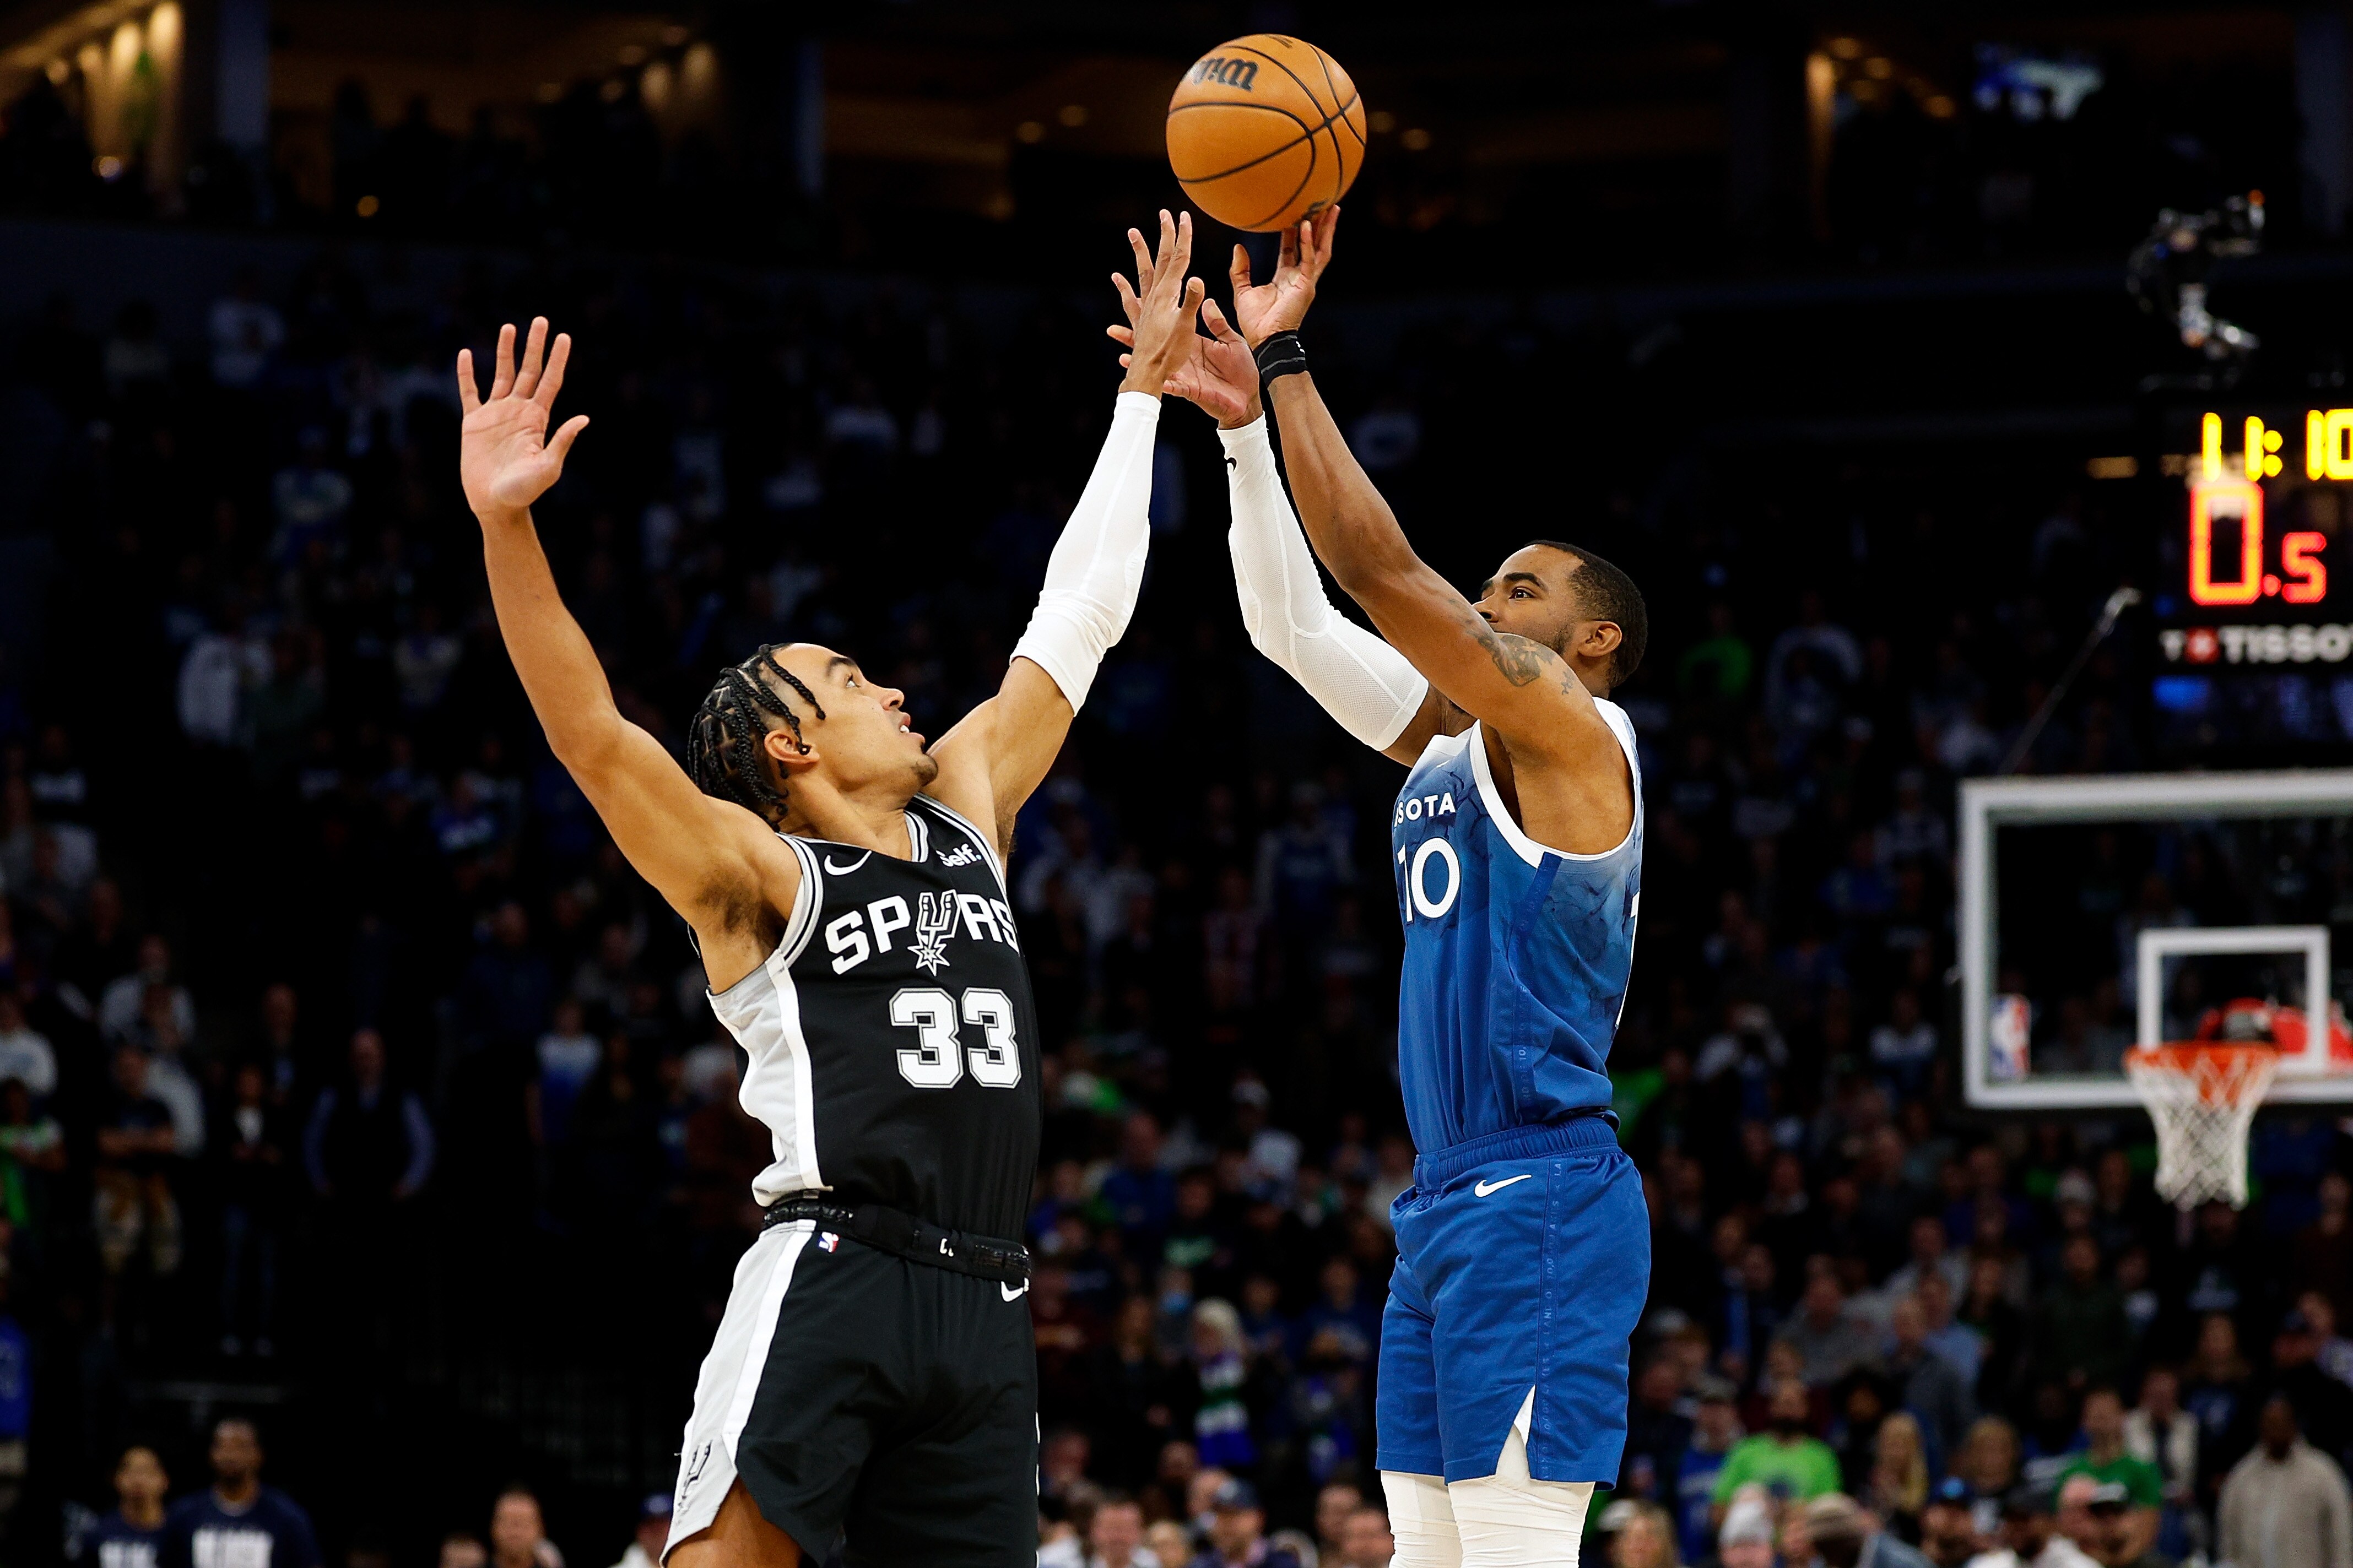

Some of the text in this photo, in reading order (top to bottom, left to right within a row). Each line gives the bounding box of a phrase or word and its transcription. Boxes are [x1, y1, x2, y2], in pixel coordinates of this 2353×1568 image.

[2189, 481, 2326, 605] 0.5
[2219, 623, 2353, 663] TISSO
[1394, 792, 1456, 827] SOTA
[1397, 837, 1460, 923] 10
[825, 889, 1020, 976] SPURS
[889, 988, 1022, 1089] 33
